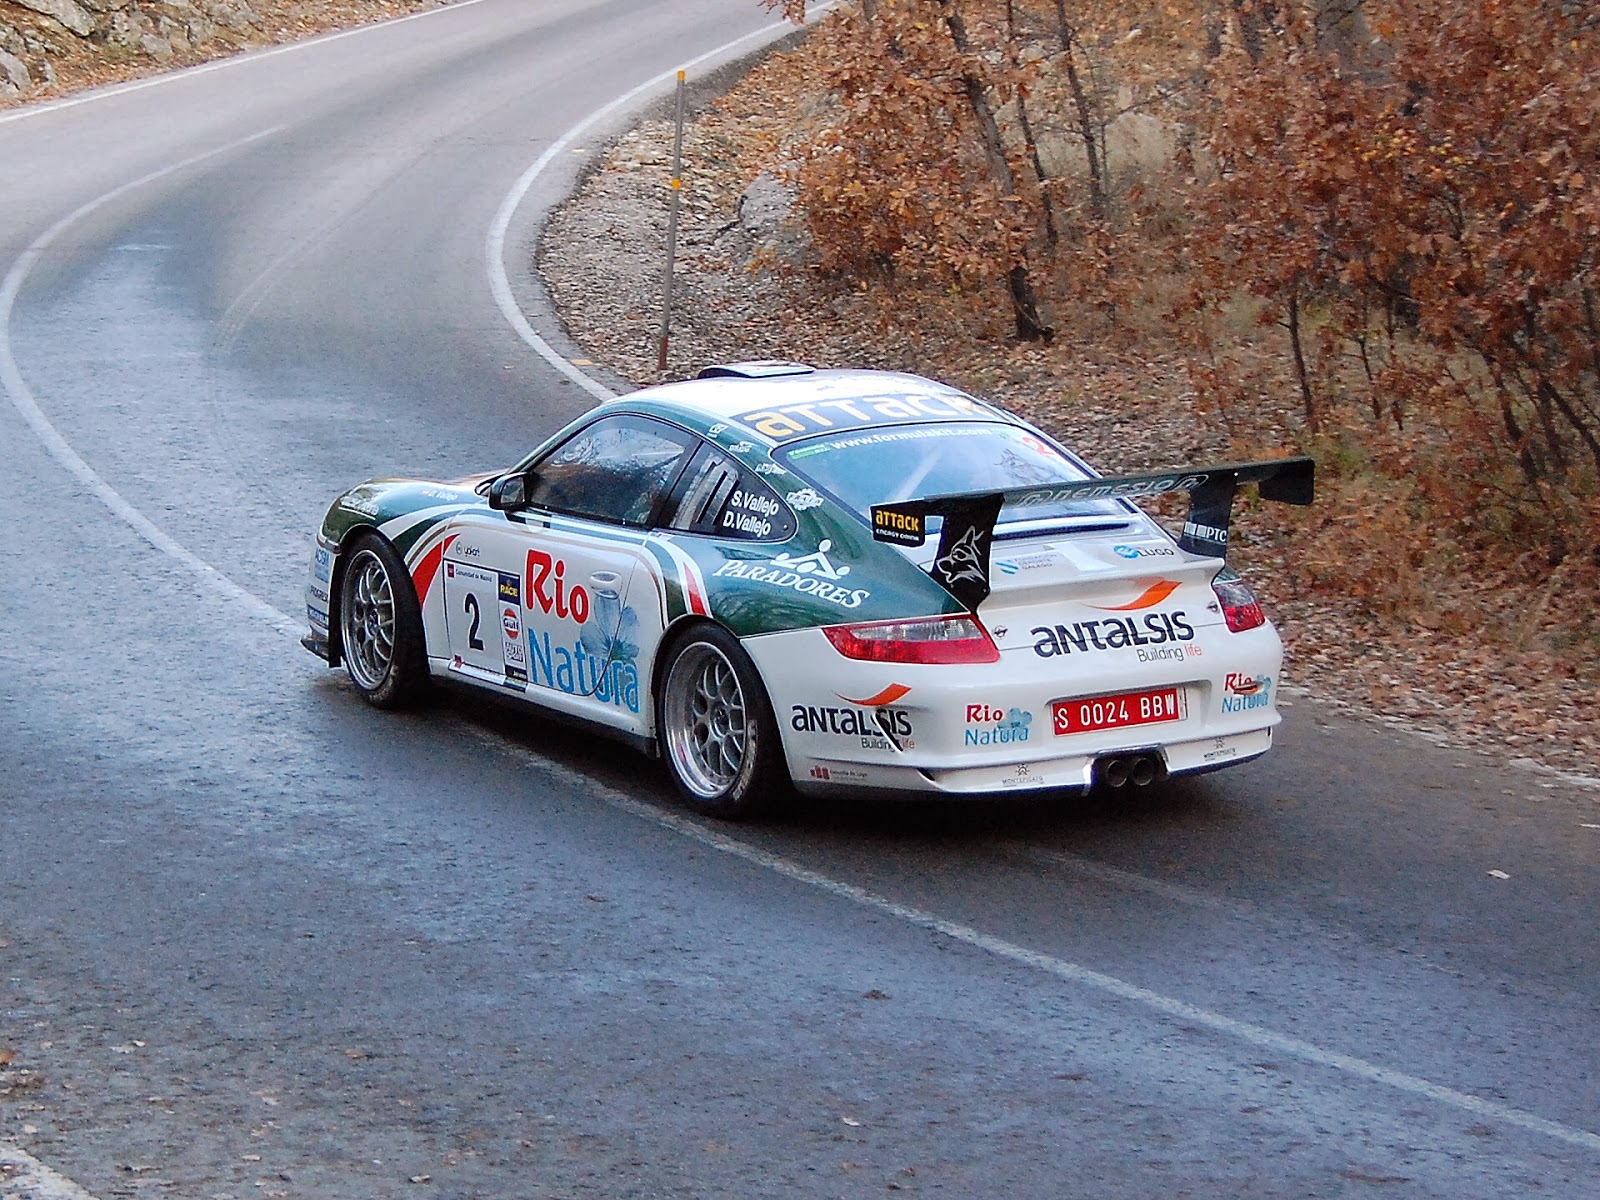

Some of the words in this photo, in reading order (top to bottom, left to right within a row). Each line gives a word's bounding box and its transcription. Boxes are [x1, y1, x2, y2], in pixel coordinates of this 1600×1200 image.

[830, 427, 993, 449] www.formulakit.com
[731, 490, 780, 517] S.Vallejo
[723, 511, 772, 537] D.Vallejo
[1206, 526, 1227, 542] PTC
[1137, 548, 1174, 557] LUGO
[526, 549, 590, 624] Rio
[712, 559, 870, 608] PARADORES
[464, 592, 485, 651] 2
[503, 617, 519, 631] Gulf
[1137, 645, 1183, 662] Building
[1184, 643, 1202, 656] life
[528, 628, 640, 713] Natura
[966, 704, 1004, 723] Rio
[1057, 708, 1069, 730] S
[1080, 702, 1129, 726] 0024
[1140, 693, 1175, 719] BBW
[1221, 692, 1269, 713] Natura
[965, 726, 1030, 746] Natura
